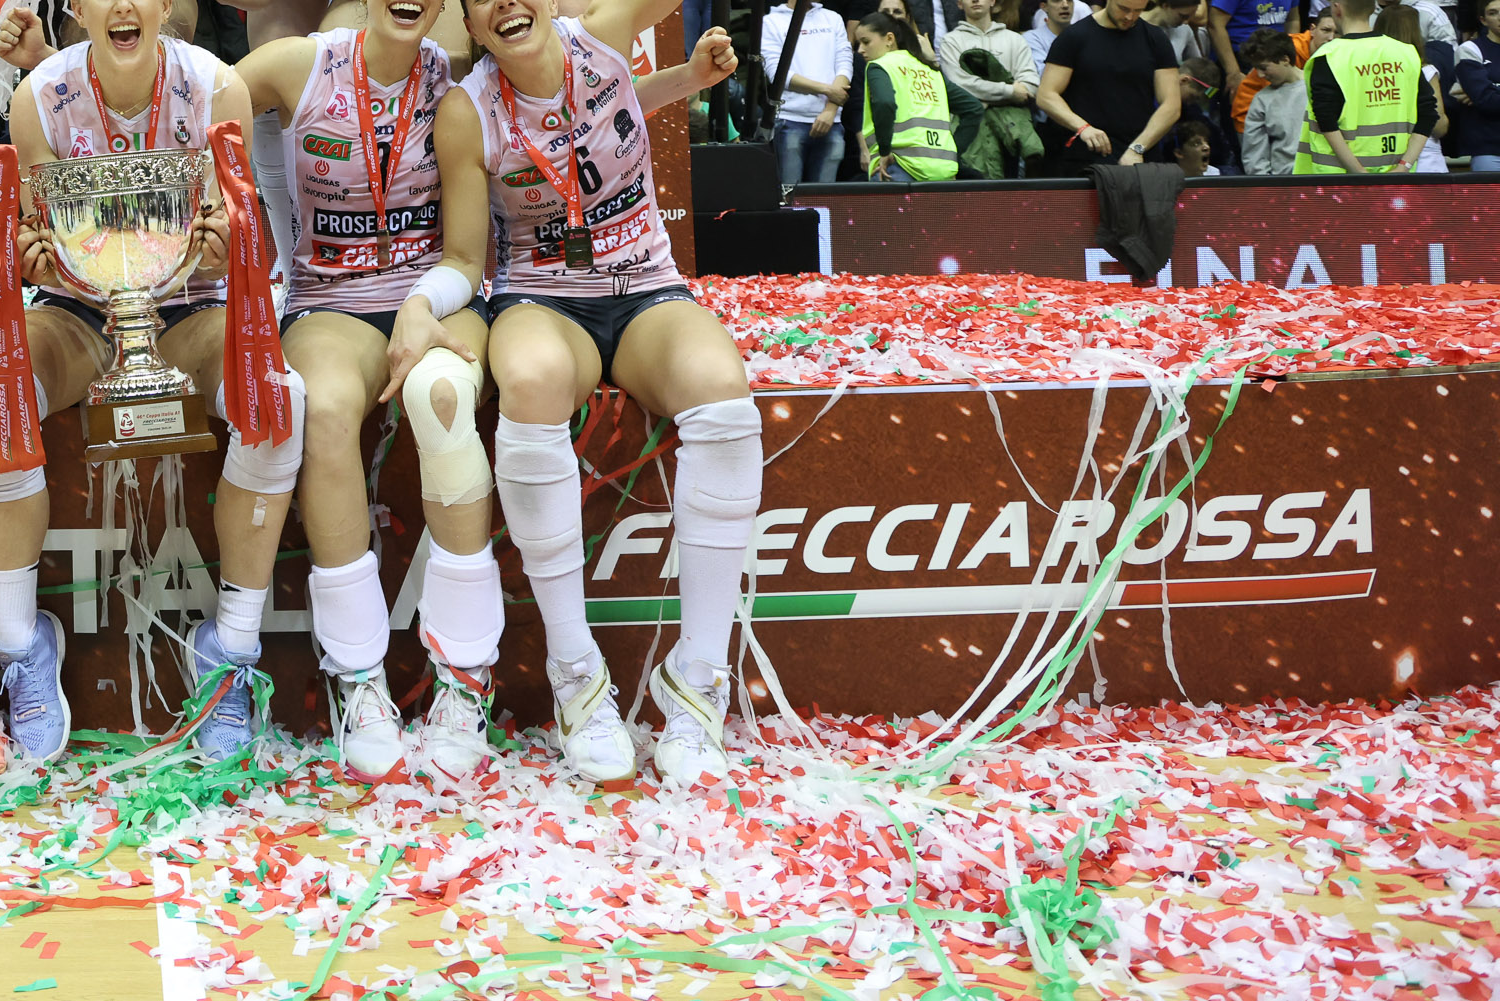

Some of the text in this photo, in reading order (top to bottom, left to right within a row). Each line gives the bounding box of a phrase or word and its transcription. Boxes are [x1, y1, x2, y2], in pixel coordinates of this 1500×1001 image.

[1355, 62, 1404, 77] WORK
[913, 80, 933, 91] ON
[1373, 75, 1396, 89] ON
[910, 89, 939, 102] TIME
[1364, 88, 1401, 103] TIME
[926, 129, 942, 147] 02
[1381, 135, 1397, 154] 30
[304, 136, 350, 160] CRAI
[366, 131, 377, 174] FRECCIAROSSA
[505, 170, 549, 187] CRA
[576, 145, 604, 196] 6
[305, 173, 341, 188] LIQUIGAS
[408, 181, 442, 196] lavorop
[519, 199, 558, 211] LIQUIGAS
[316, 211, 414, 234] PROSECO
[658, 209, 687, 221] OUP
[240, 191, 260, 268] FRECCIAROSSA
[641, 264, 660, 273] design
[244, 352, 257, 432] FRECCIAROSSA
[0, 383, 10, 461] FRECCIAROSSA
[17, 375, 33, 455] FRECCIAROSSA
[591, 488, 1373, 581] FECCIAROSSA
